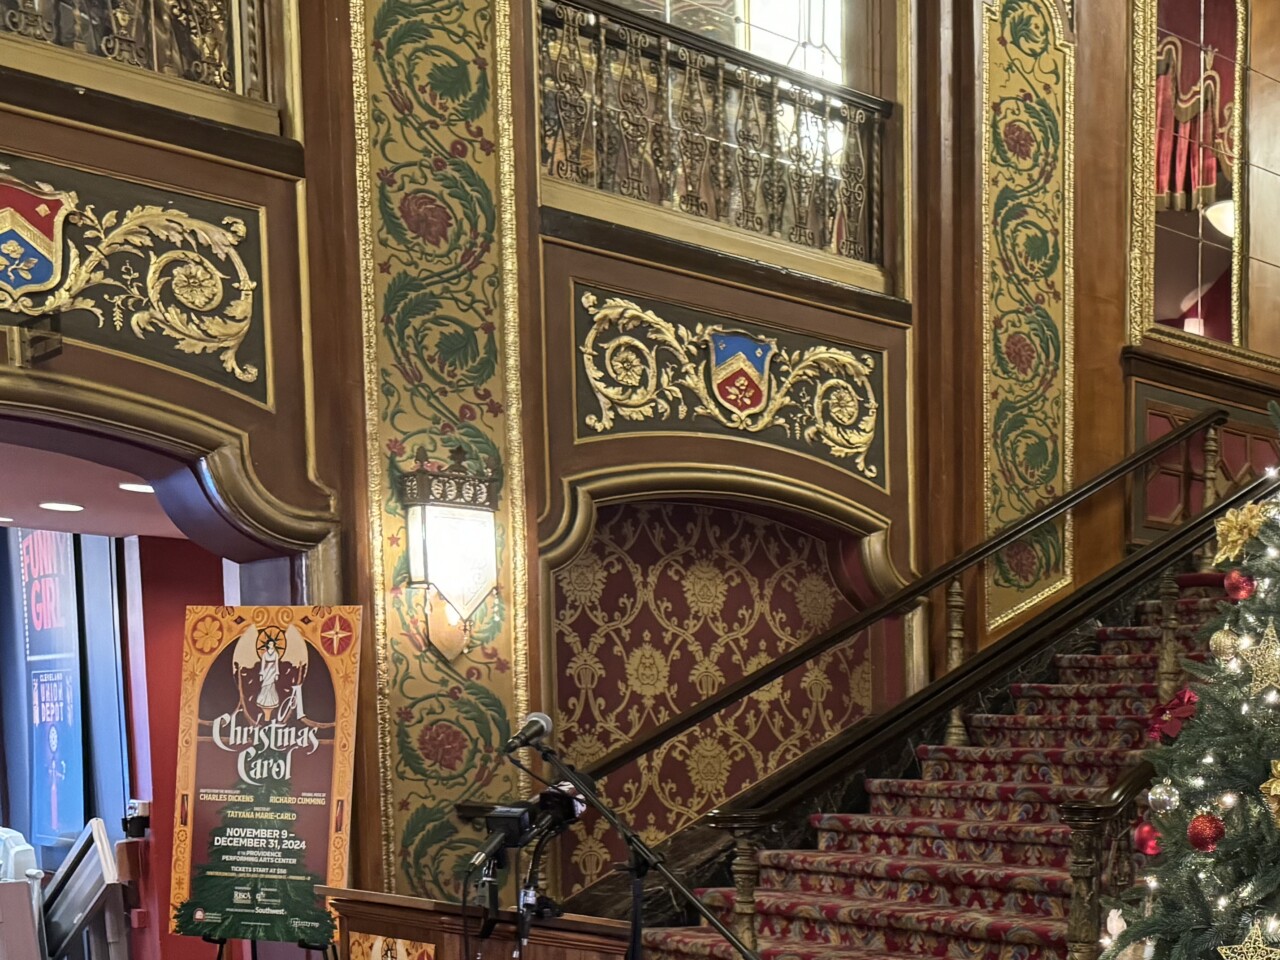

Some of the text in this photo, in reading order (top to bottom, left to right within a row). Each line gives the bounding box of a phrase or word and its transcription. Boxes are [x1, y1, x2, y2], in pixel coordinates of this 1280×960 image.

[22, 530, 66, 583] FUNNY
[31, 577, 65, 631] GIRL
[278, 685, 306, 720] A
[42, 702, 64, 722] DEPOT
[212, 708, 319, 755] Christmas
[237, 746, 299, 786] Carol
[199, 793, 254, 803] CHARLES DICKENS
[269, 795, 297, 804] RICHARD
[226, 827, 279, 839] NOVEMBER
[281, 829, 288, 839] 9
[214, 836, 306, 850] DECEMBER 31, 2024
[221, 855, 259, 863] PERFORMING
[246, 850, 282, 858] PROVIDENCE
[231, 865, 252, 873] TICKETS
[255, 907, 285, 915] Southwest
